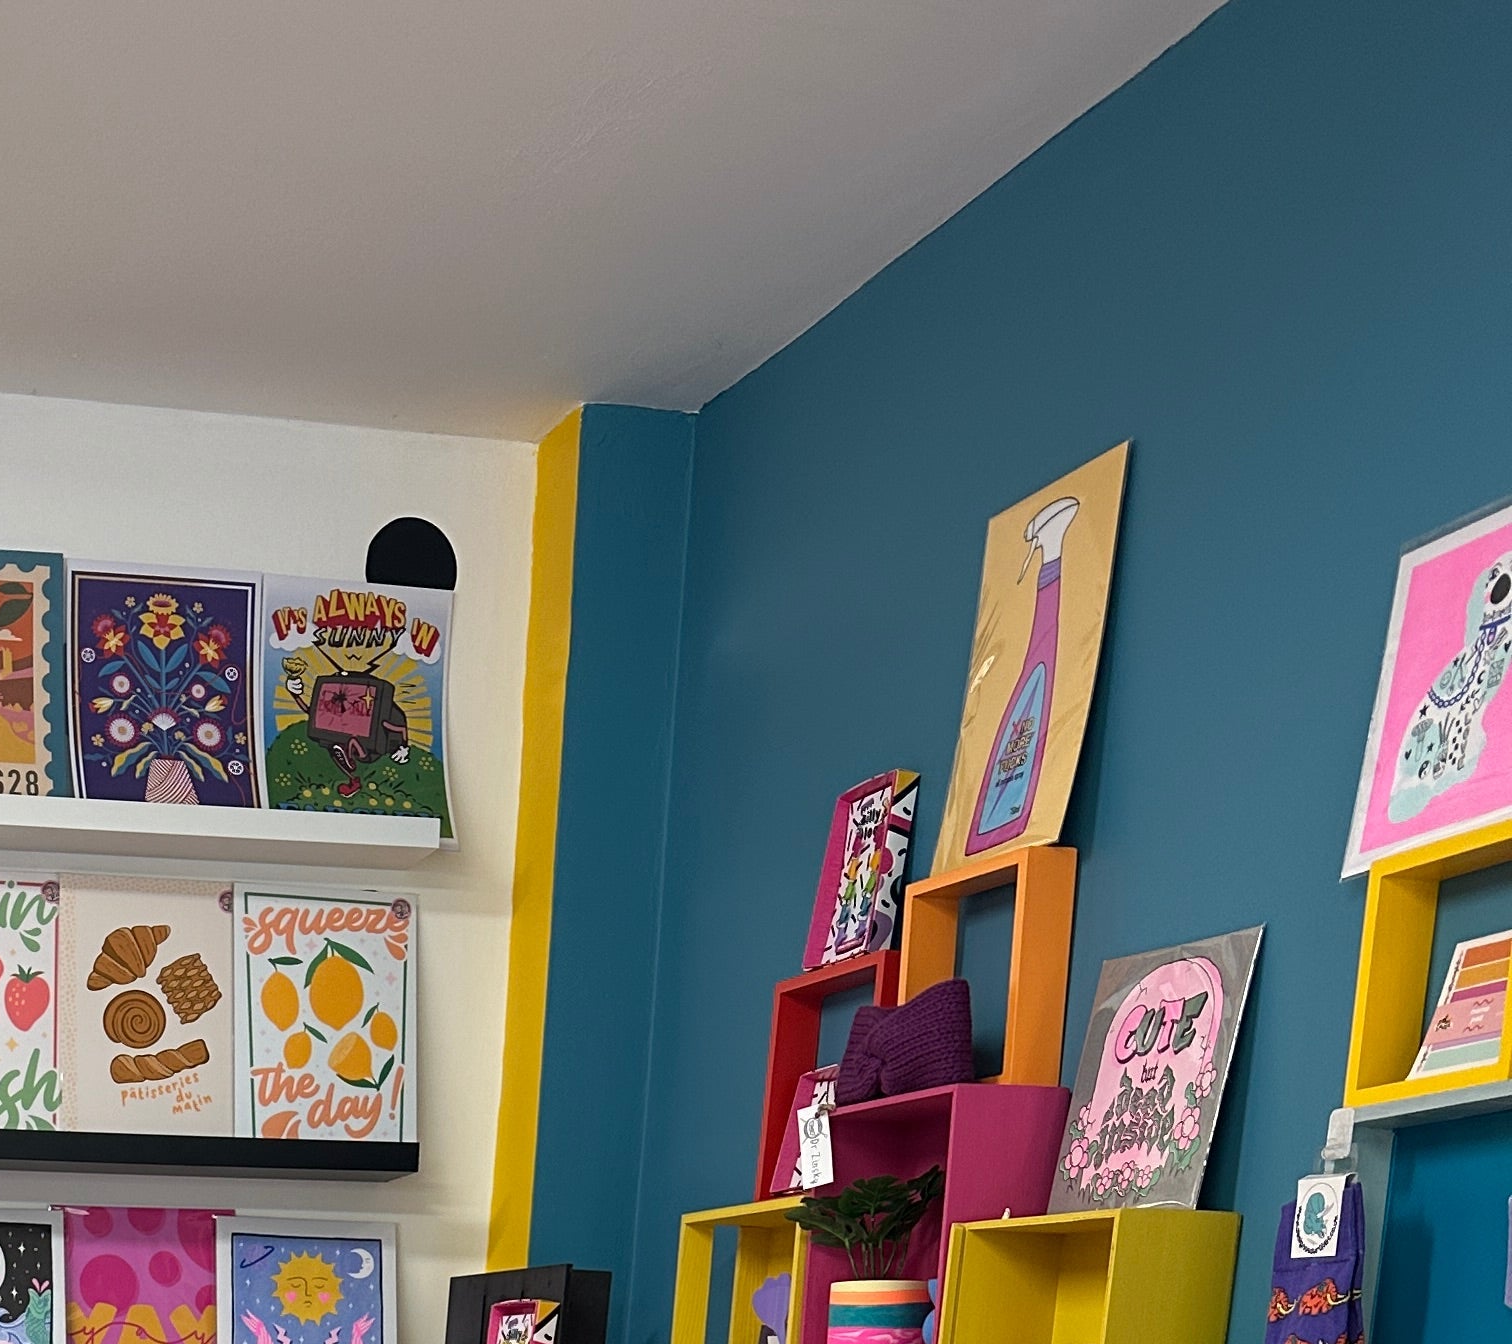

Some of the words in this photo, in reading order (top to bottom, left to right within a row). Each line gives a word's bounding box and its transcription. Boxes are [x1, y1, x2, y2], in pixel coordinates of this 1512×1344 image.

[313, 589, 406, 629] ALWAYS
[311, 626, 406, 648] SUNNY
[247, 906, 409, 955] squeeze
[1114, 991, 1208, 1064] CUTE
